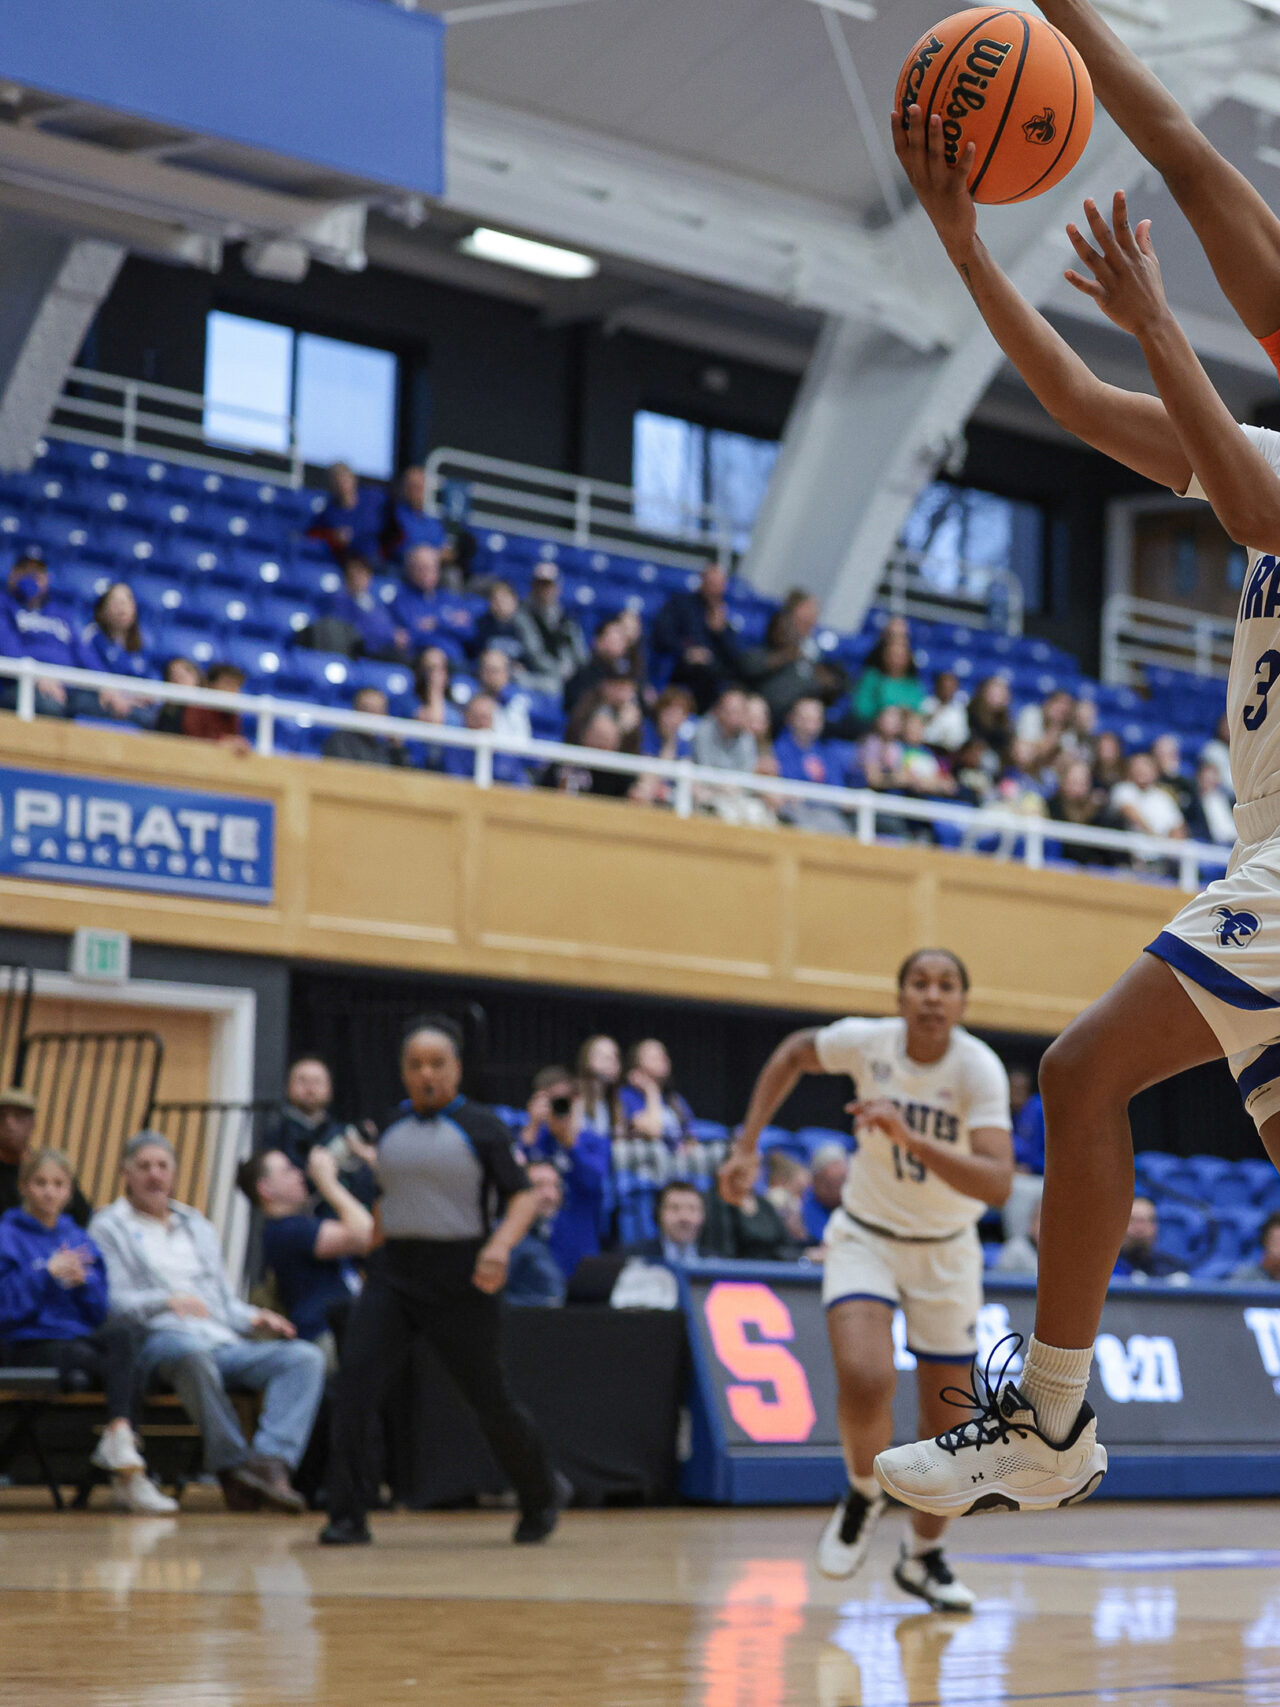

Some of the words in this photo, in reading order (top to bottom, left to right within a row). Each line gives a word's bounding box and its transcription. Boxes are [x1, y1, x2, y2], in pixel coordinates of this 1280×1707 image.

[941, 37, 1014, 166] Wilson
[10, 834, 258, 884] BASKETBALL
[13, 788, 261, 863] PIRATE
[703, 1281, 818, 1443] S
